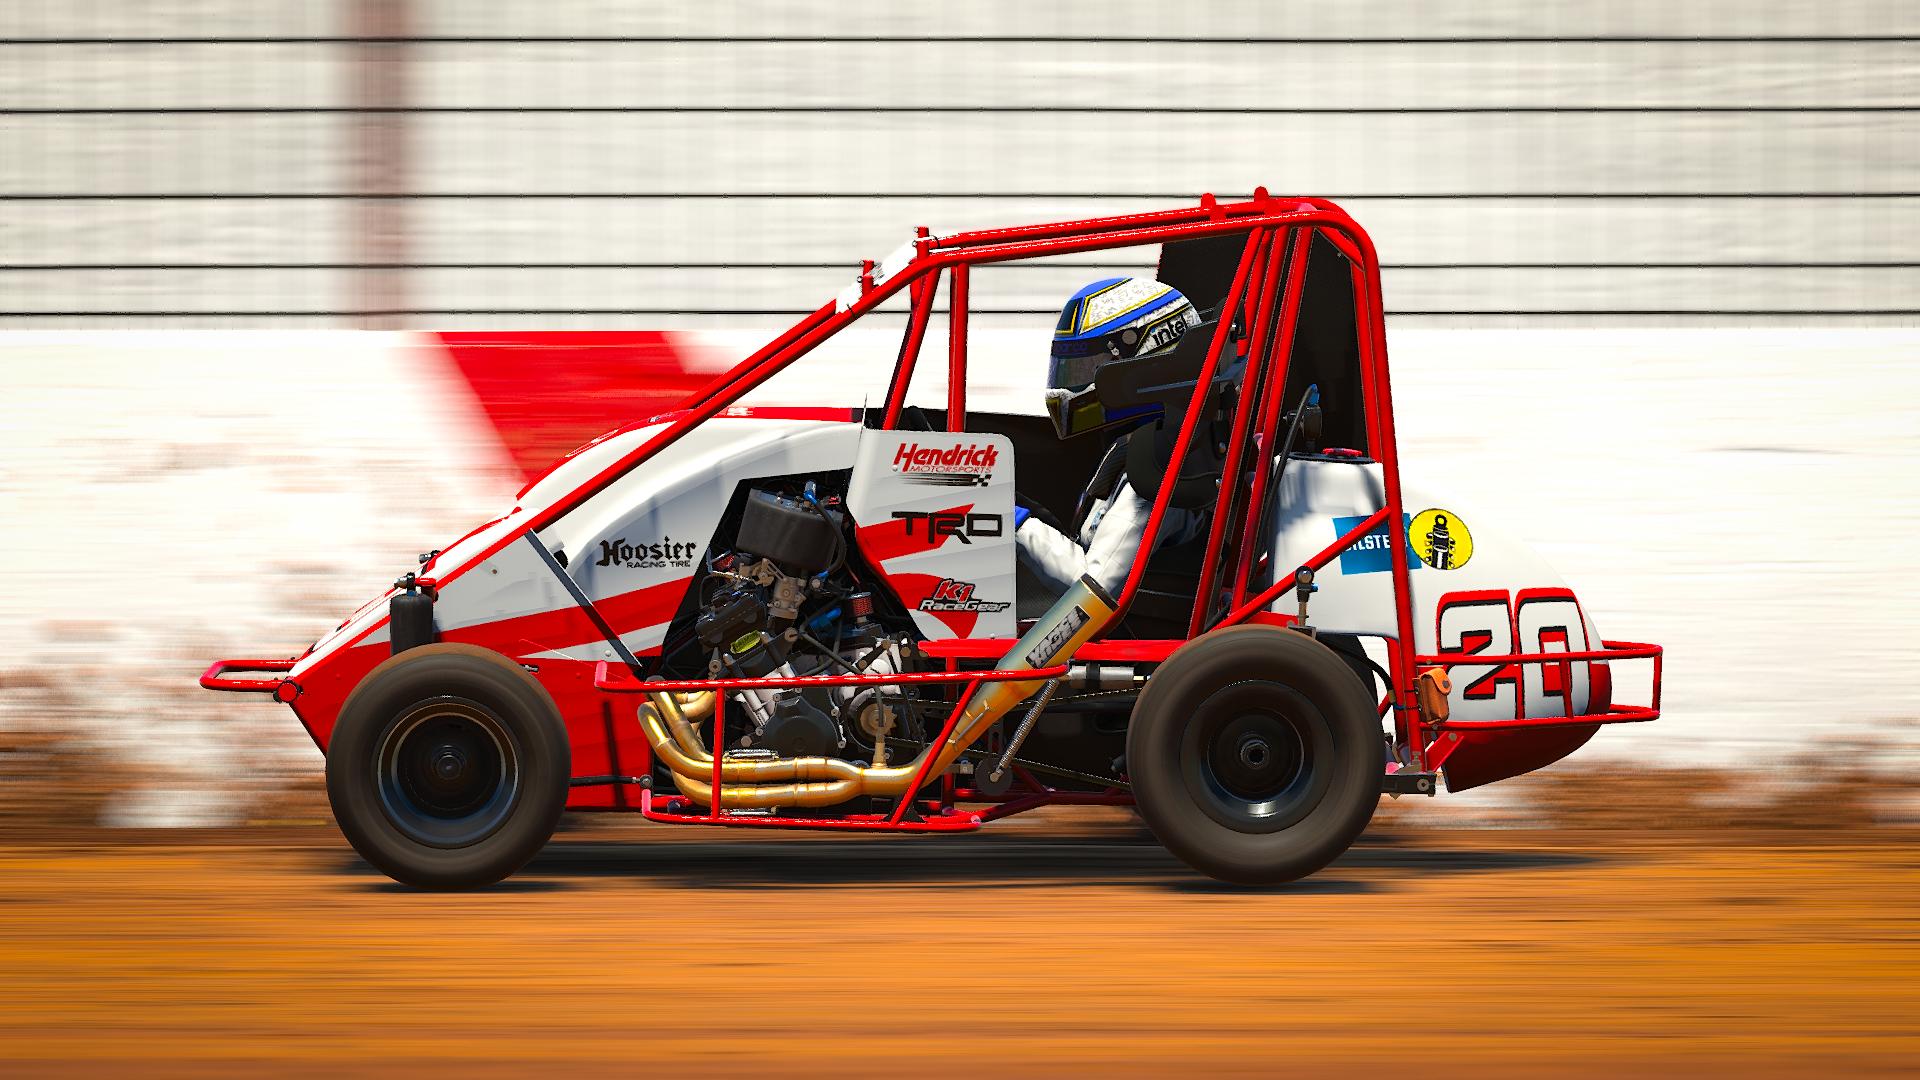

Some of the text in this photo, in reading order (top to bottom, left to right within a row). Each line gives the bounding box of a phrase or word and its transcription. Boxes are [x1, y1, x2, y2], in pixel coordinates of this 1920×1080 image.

[1151, 313, 1188, 346] intel
[893, 443, 999, 472] Hendrick
[908, 465, 992, 474] MOTORSPORTS
[891, 511, 1002, 545] TRD
[595, 535, 697, 567] Hoosier
[1346, 532, 1408, 551] LSTE
[626, 560, 691, 569] RACING TIRE
[934, 579, 975, 603] K1
[919, 599, 1011, 613] RaceGear
[1436, 587, 1591, 721] 20
